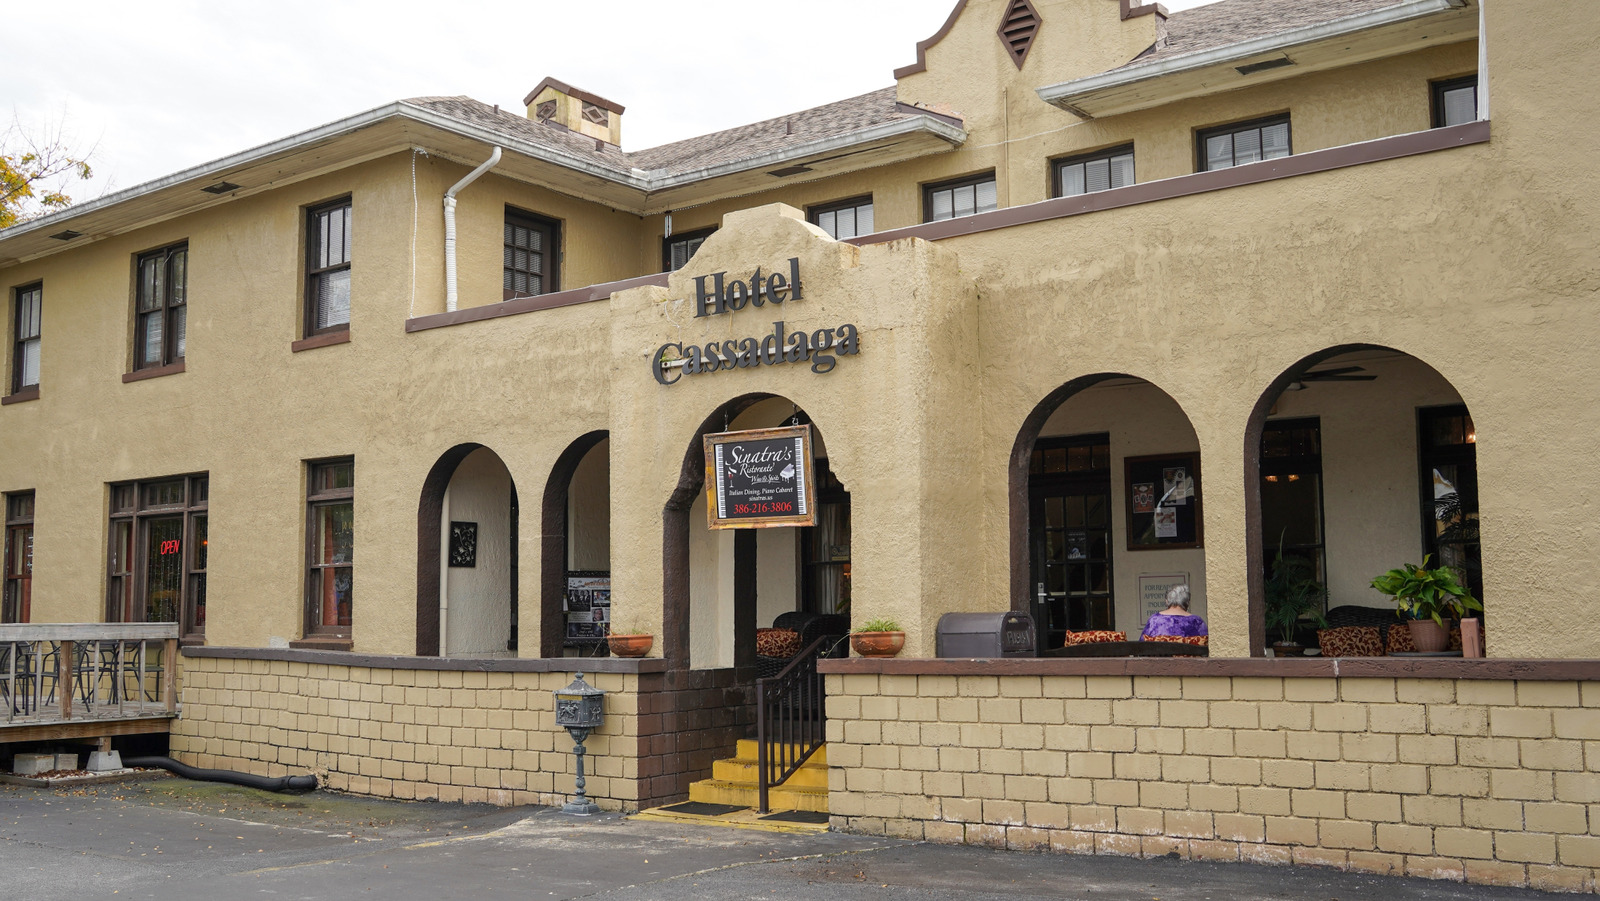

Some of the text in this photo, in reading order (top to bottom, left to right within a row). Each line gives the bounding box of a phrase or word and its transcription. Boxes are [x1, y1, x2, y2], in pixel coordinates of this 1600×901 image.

[692, 257, 804, 319] Hotel
[652, 321, 859, 385] Cassadaga
[732, 446, 792, 464] Sinatra's
[775, 486, 793, 494] Cabaret
[733, 502, 792, 514] 386-216-3806
[160, 539, 181, 555] OPEN
